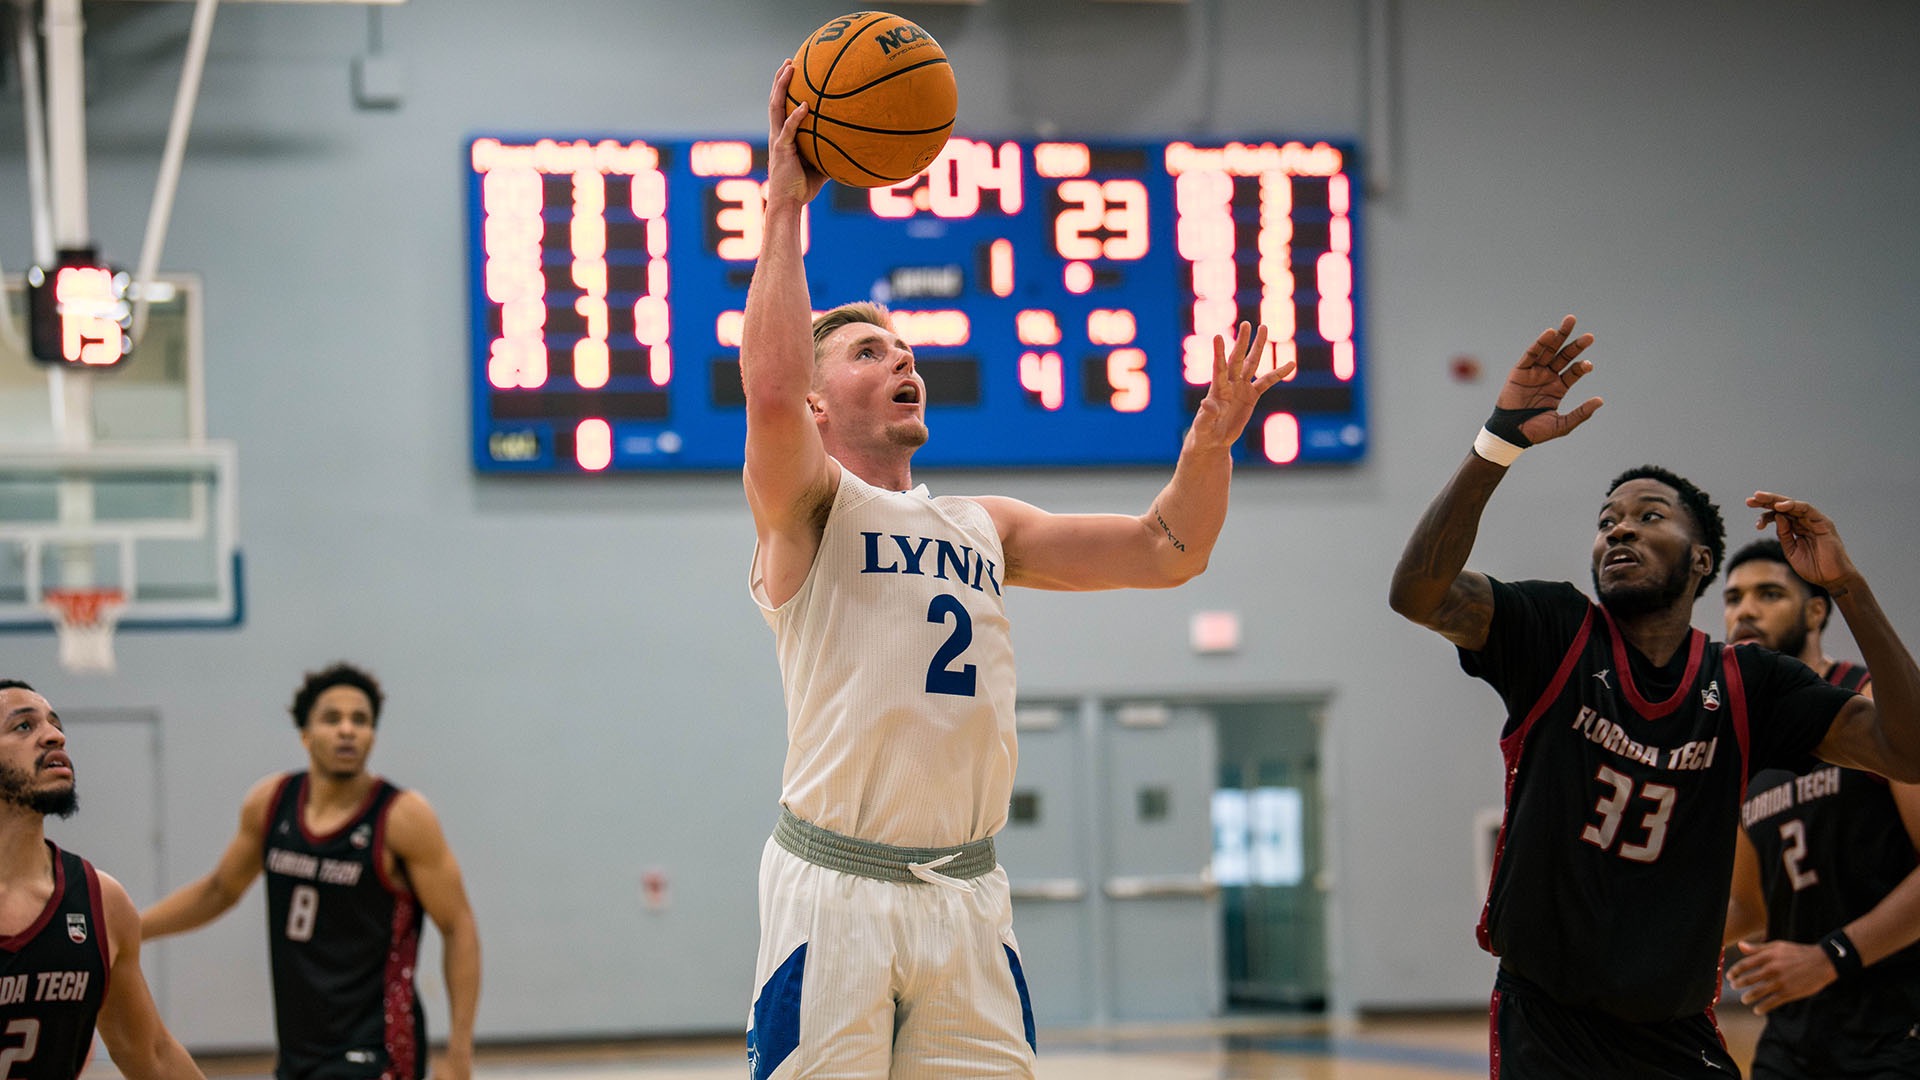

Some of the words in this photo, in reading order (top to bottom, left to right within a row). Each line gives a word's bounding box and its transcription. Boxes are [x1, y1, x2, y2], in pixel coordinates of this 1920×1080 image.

[875, 25, 930, 55] NCA
[1055, 179, 1150, 260] 23
[1018, 351, 1063, 411] 4
[1107, 347, 1150, 412] 5
[860, 531, 1002, 596] LYNN
[924, 593, 977, 697] 2
[1571, 704, 1660, 767] FLORIDA
[1580, 763, 1677, 863] 33
[1796, 766, 1839, 804] TECH
[1779, 818, 1819, 891] 2
[285, 884, 320, 942] 8
[34, 971, 89, 1001] TECH
